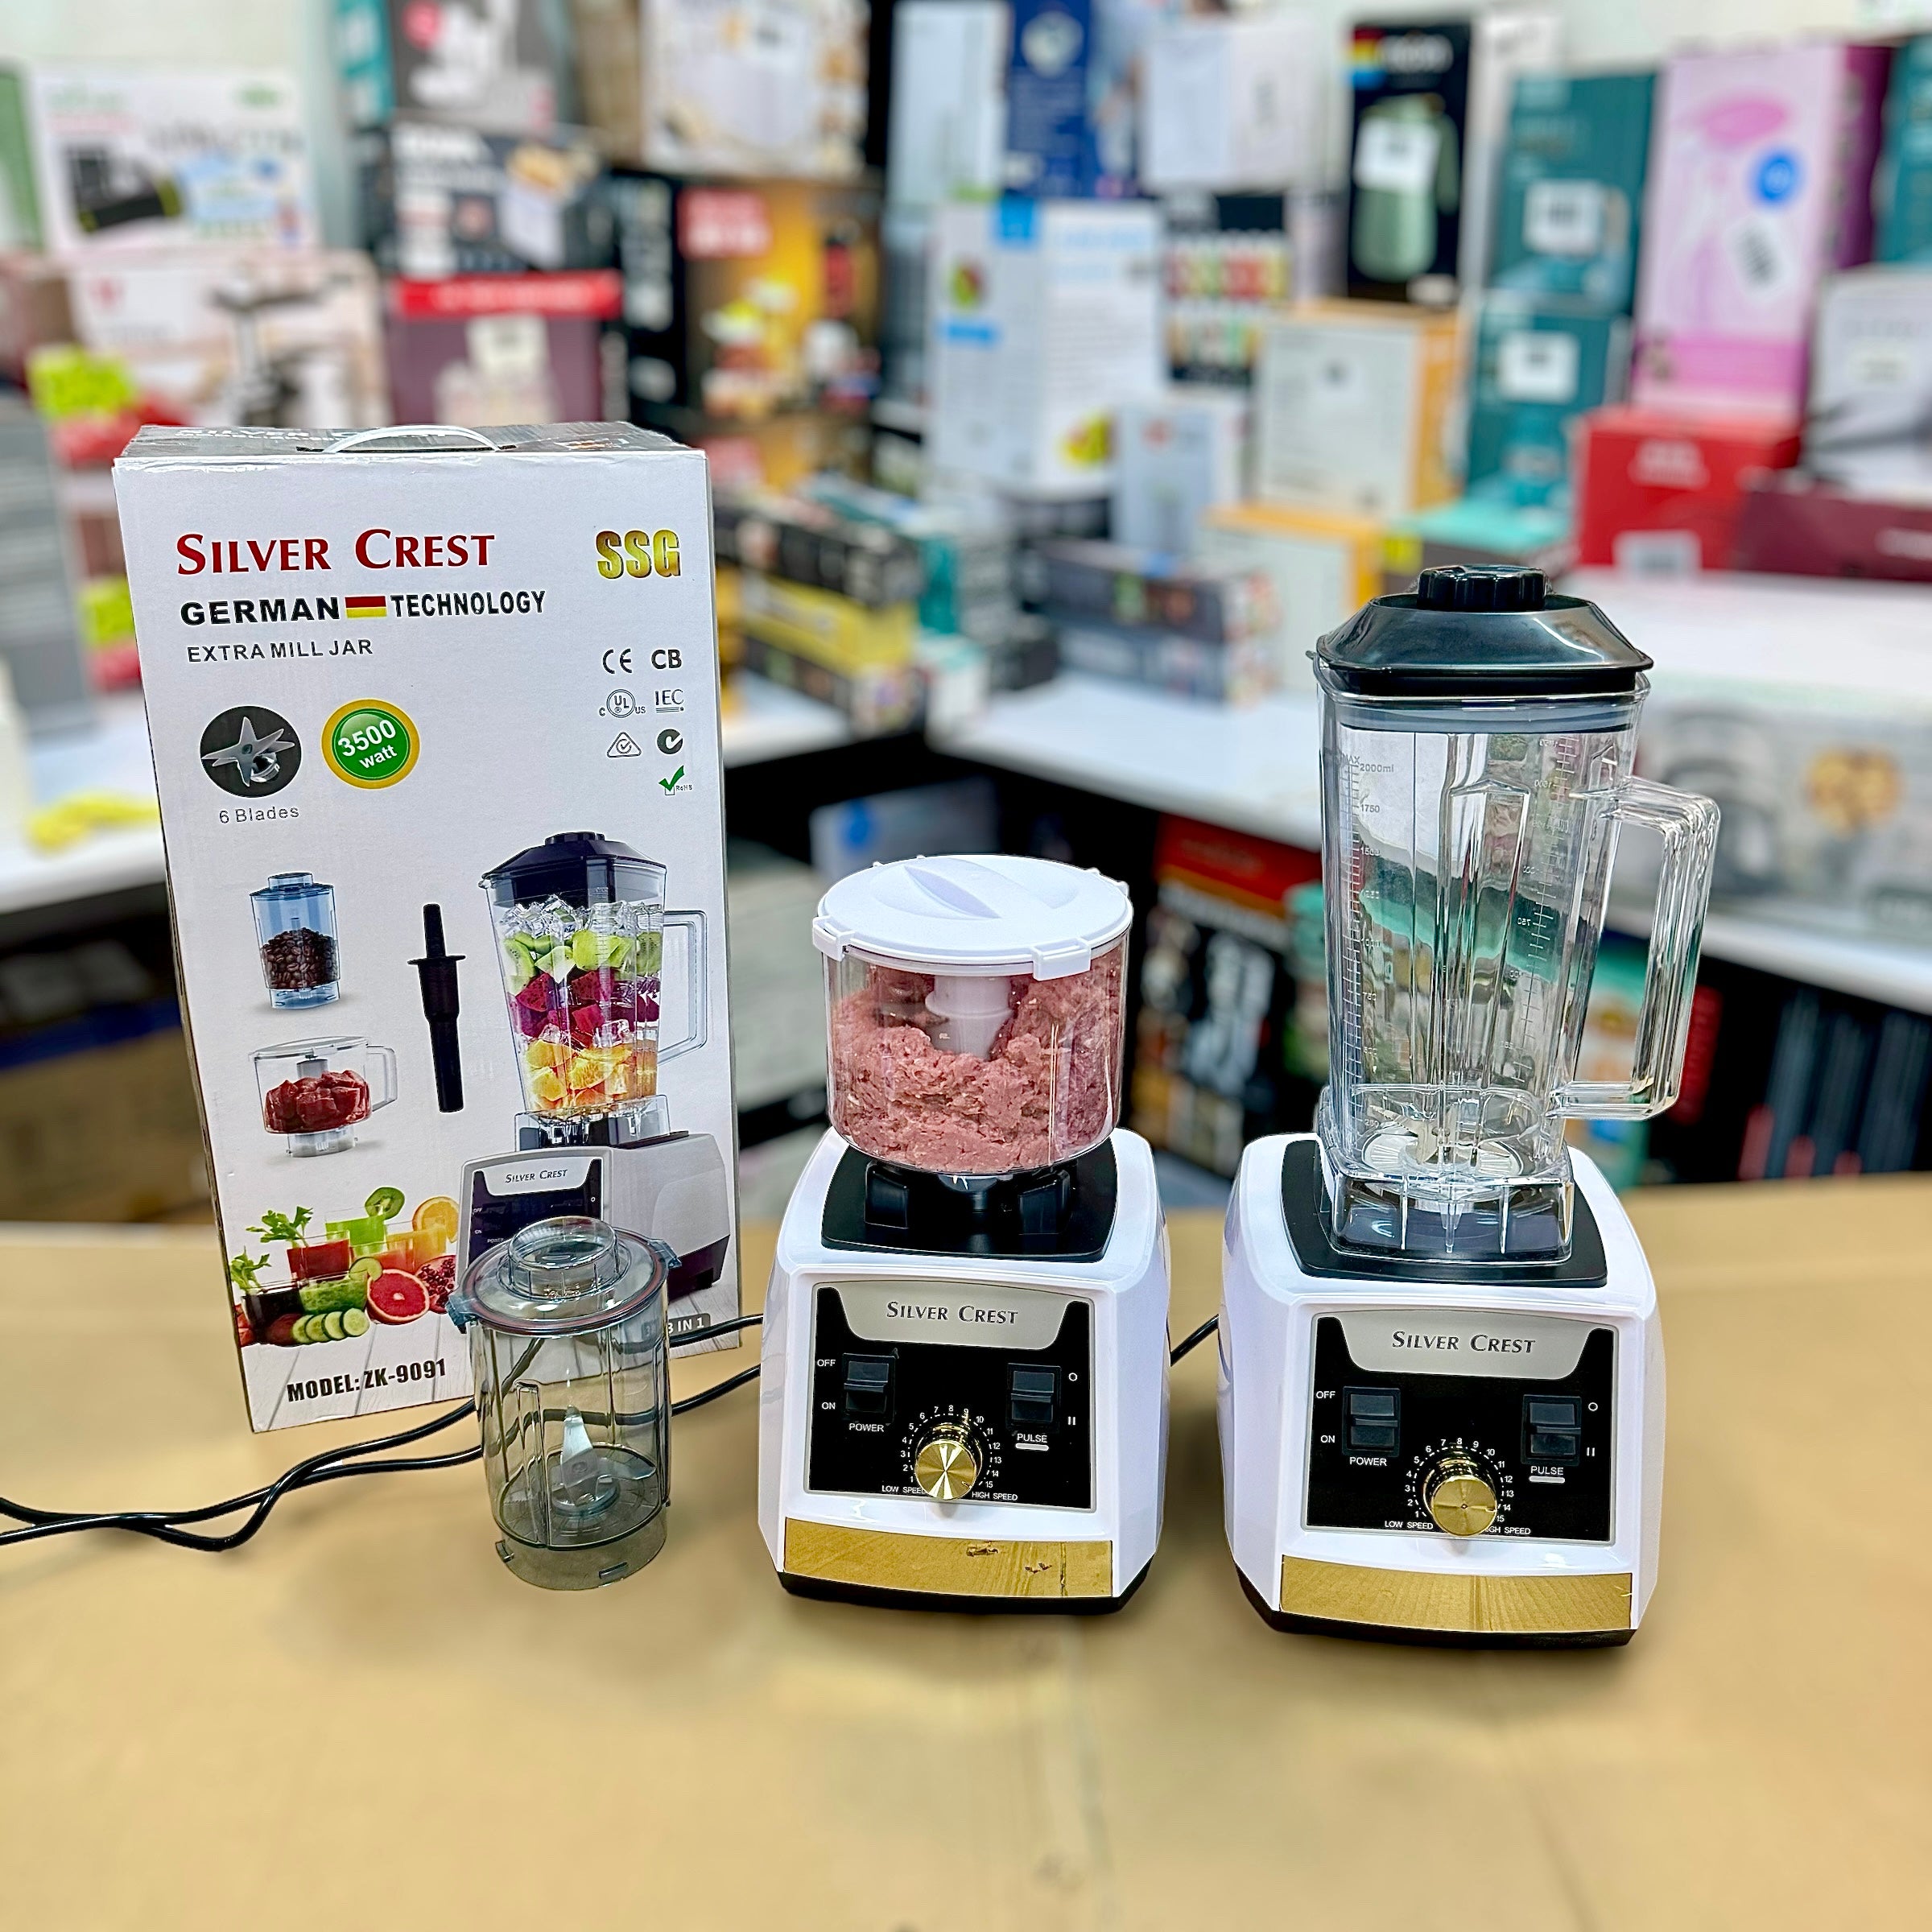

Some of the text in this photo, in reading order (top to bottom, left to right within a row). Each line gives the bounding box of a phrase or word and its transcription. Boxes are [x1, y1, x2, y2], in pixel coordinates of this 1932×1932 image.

[176, 528, 496, 576] SILVER CREST
[596, 529, 681, 579] SSG
[180, 590, 546, 626] GERMAN TECHNOLOGY
[187, 638, 374, 663] EXTRA MILL JAR
[603, 648, 633, 674] CE
[651, 649, 682, 670] CB
[654, 689, 684, 705] IEC
[613, 695, 630, 709] UL
[635, 706, 646, 714] US
[337, 719, 396, 757] 3500
[358, 744, 398, 770] watt
[1360, 763, 1394, 773] 2000ml
[219, 806, 299, 824] 6 Blades
[1360, 804, 1380, 813] 1750
[506, 1170, 568, 1183] SILVER CREST
[886, 1301, 1018, 1324] SILVER CREST
[678, 1319, 692, 1332] IN
[697, 1317, 704, 1328] 1
[1392, 1331, 1536, 1354] SILVER CREST
[817, 1359, 836, 1367] OFF
[287, 1358, 446, 1402] MODEL: ZK-9091
[1315, 1391, 1336, 1399] OFF
[821, 1402, 836, 1410] ON
[848, 1422, 884, 1433] POWER
[1017, 1433, 1048, 1443] PULSE
[1320, 1435, 1335, 1443] ON
[993, 1442, 1001, 1450] 12
[1349, 1456, 1387, 1467] POWER
[1406, 1470, 1412, 1478] 4
[1440, 1439, 1446, 1447] 7
[1530, 1466, 1564, 1476] PULSE
[881, 1484, 899, 1492] LOW
[972, 1491, 1018, 1501] HIGH SPEED
[1385, 1520, 1434, 1530] LOW SPEED
[1504, 1526, 1531, 1535] SPEED
